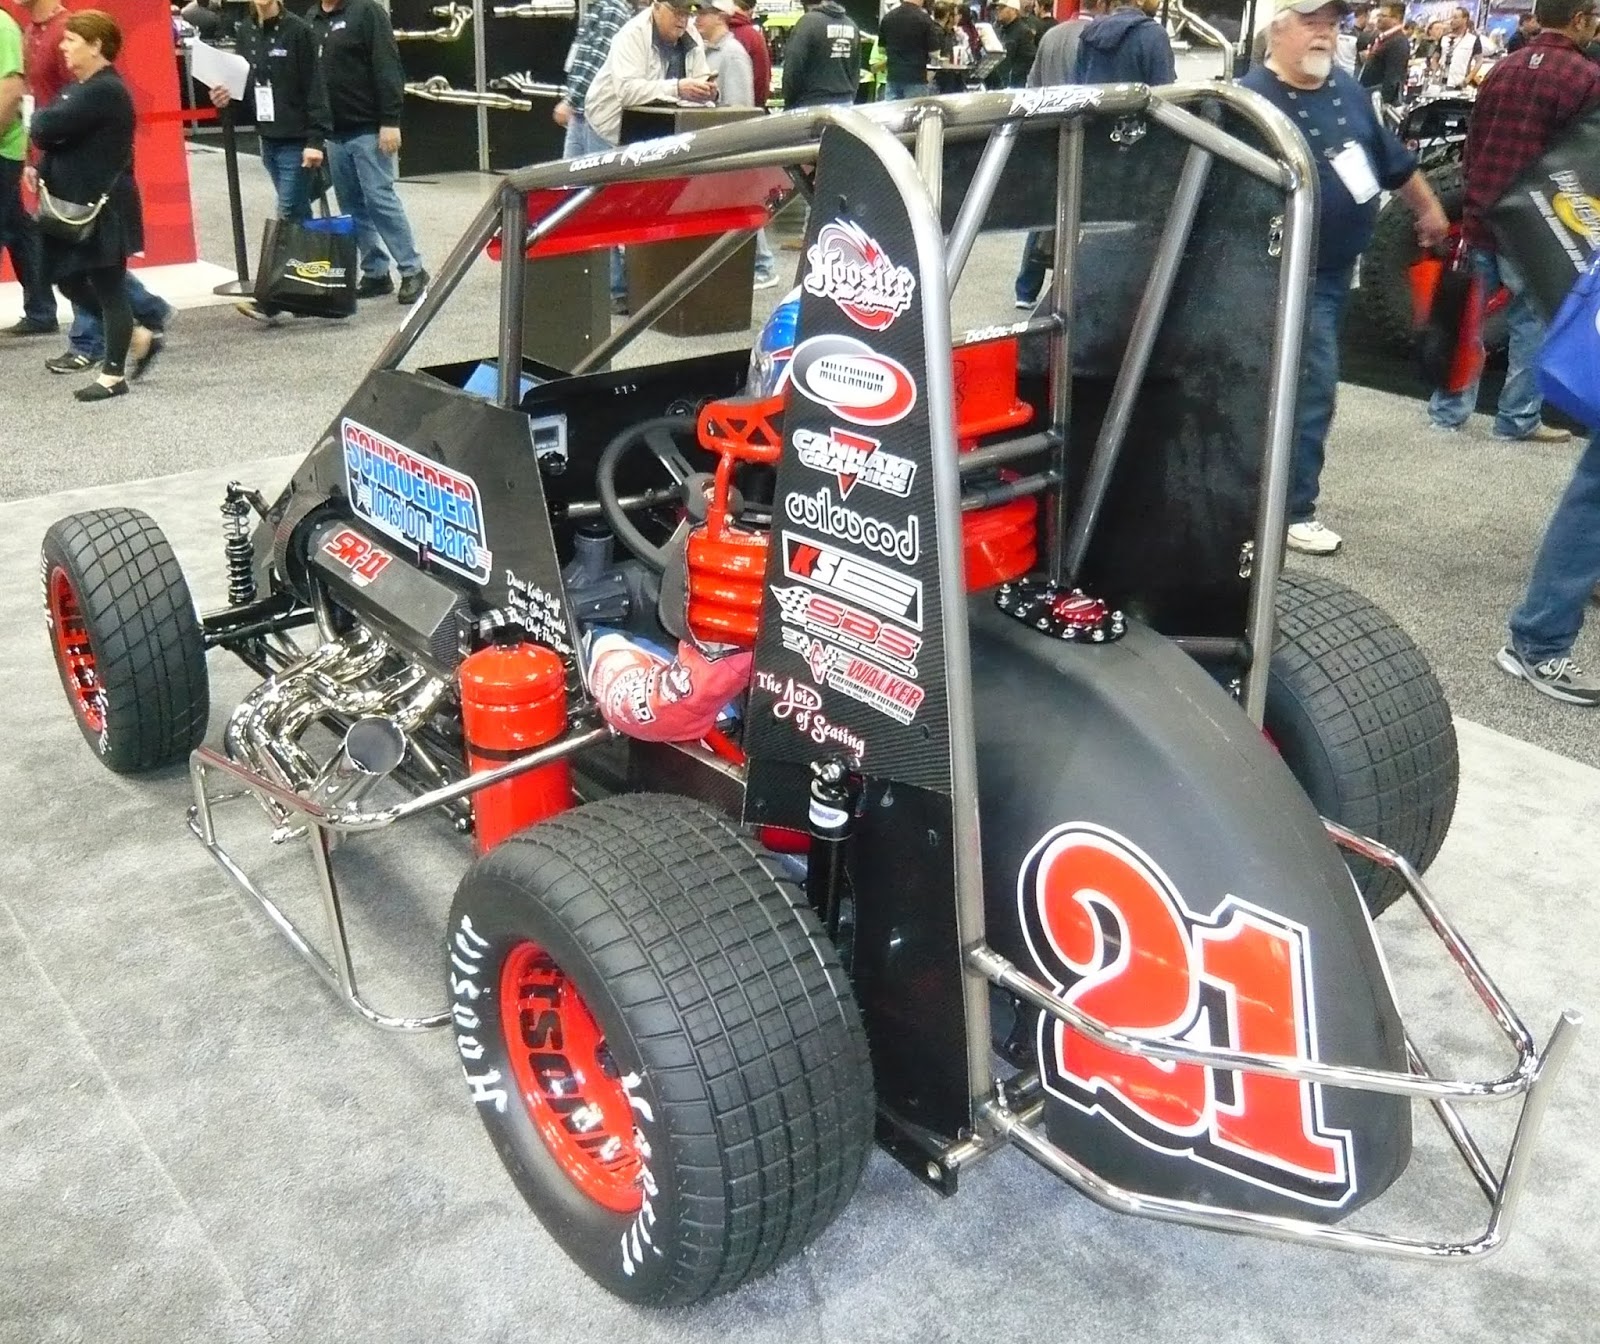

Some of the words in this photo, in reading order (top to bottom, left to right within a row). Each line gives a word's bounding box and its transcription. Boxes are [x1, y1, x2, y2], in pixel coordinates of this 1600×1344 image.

[804, 244, 916, 299] Hoosier
[345, 424, 479, 535] SCHROEDER
[794, 430, 915, 482] CANHAM
[802, 449, 908, 493] GRAPHICS
[369, 477, 428, 546] Torsion
[431, 512, 479, 570] Bars
[785, 487, 920, 566] wilwood
[789, 543, 917, 617] KSE
[805, 593, 922, 663] SBS
[757, 671, 782, 694] The
[773, 678, 822, 718] Joie
[828, 672, 876, 700] PERFORMANCE
[876, 694, 915, 720] FILTRATION
[846, 658, 923, 710] WALKER
[795, 709, 812, 731] of
[811, 715, 865, 758] Seating
[1016, 821, 1356, 1208] 21
